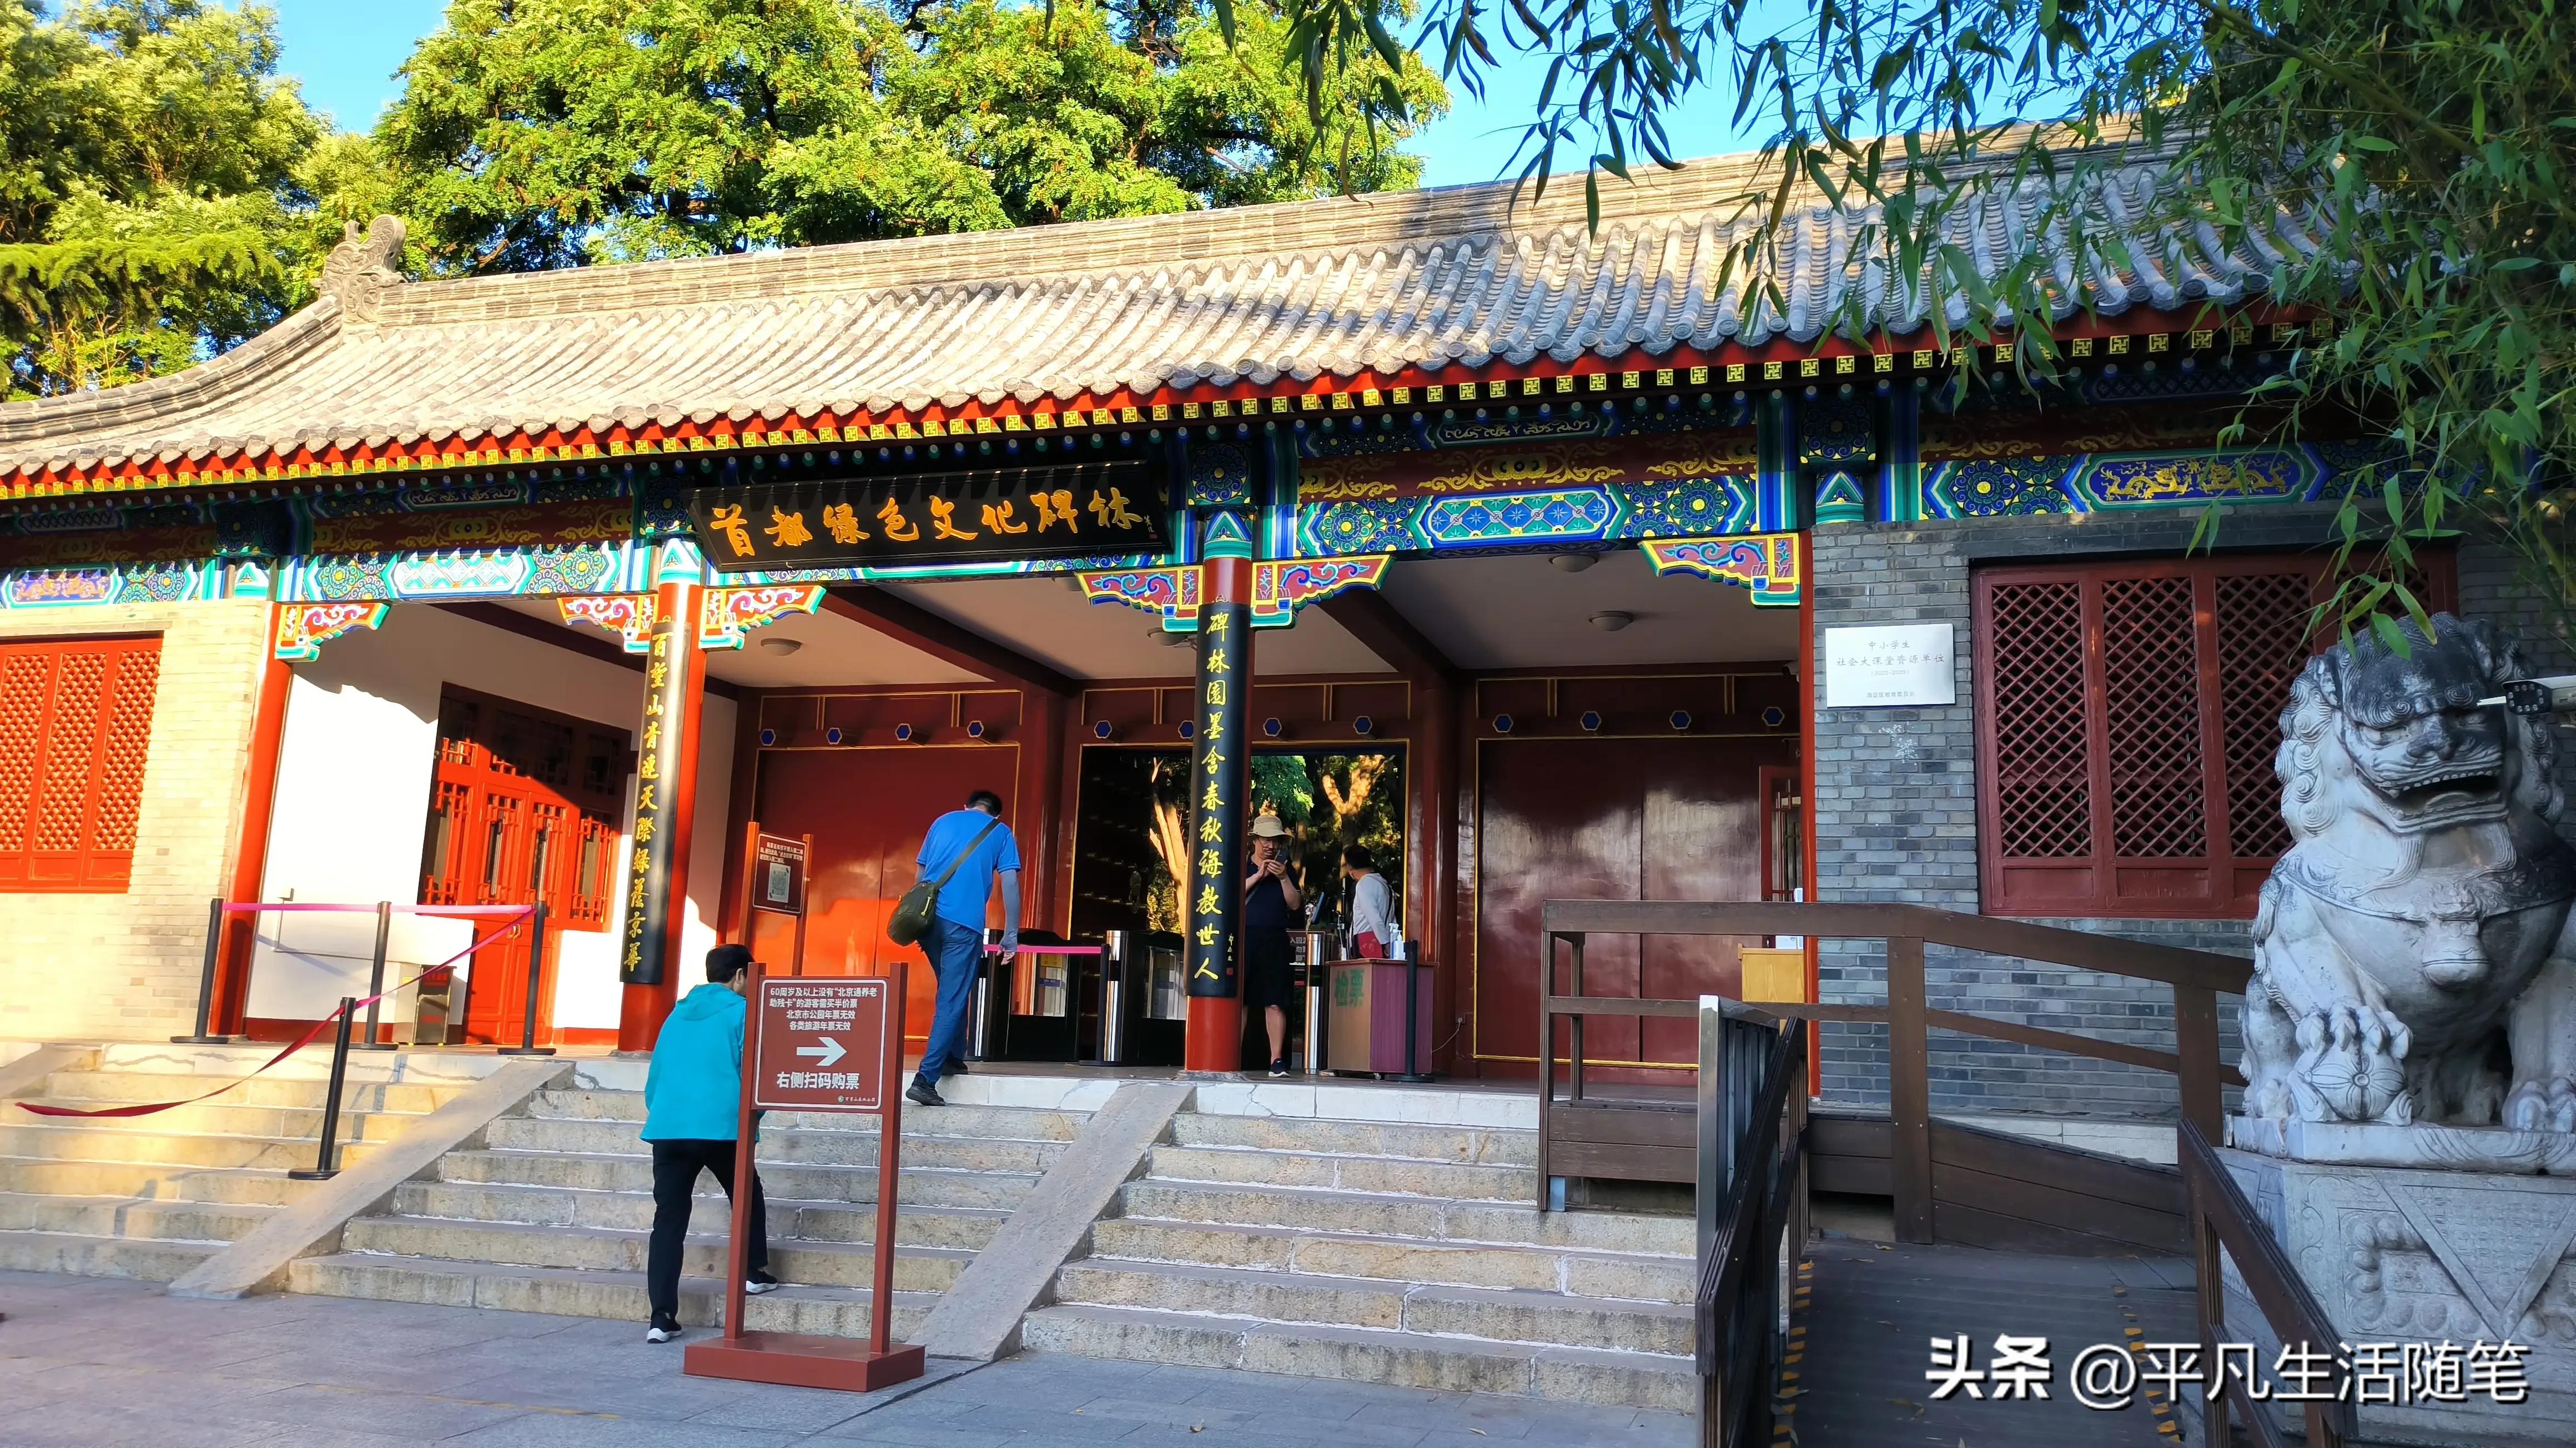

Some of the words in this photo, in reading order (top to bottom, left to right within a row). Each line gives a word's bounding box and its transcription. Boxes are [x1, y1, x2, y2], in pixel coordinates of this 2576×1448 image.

[786, 1009, 856, 1019] 北京市公园年票无效
[789, 1020, 852, 1031] 各类旅游年票无效
[776, 1071, 860, 1090] 右侧扫码购票
